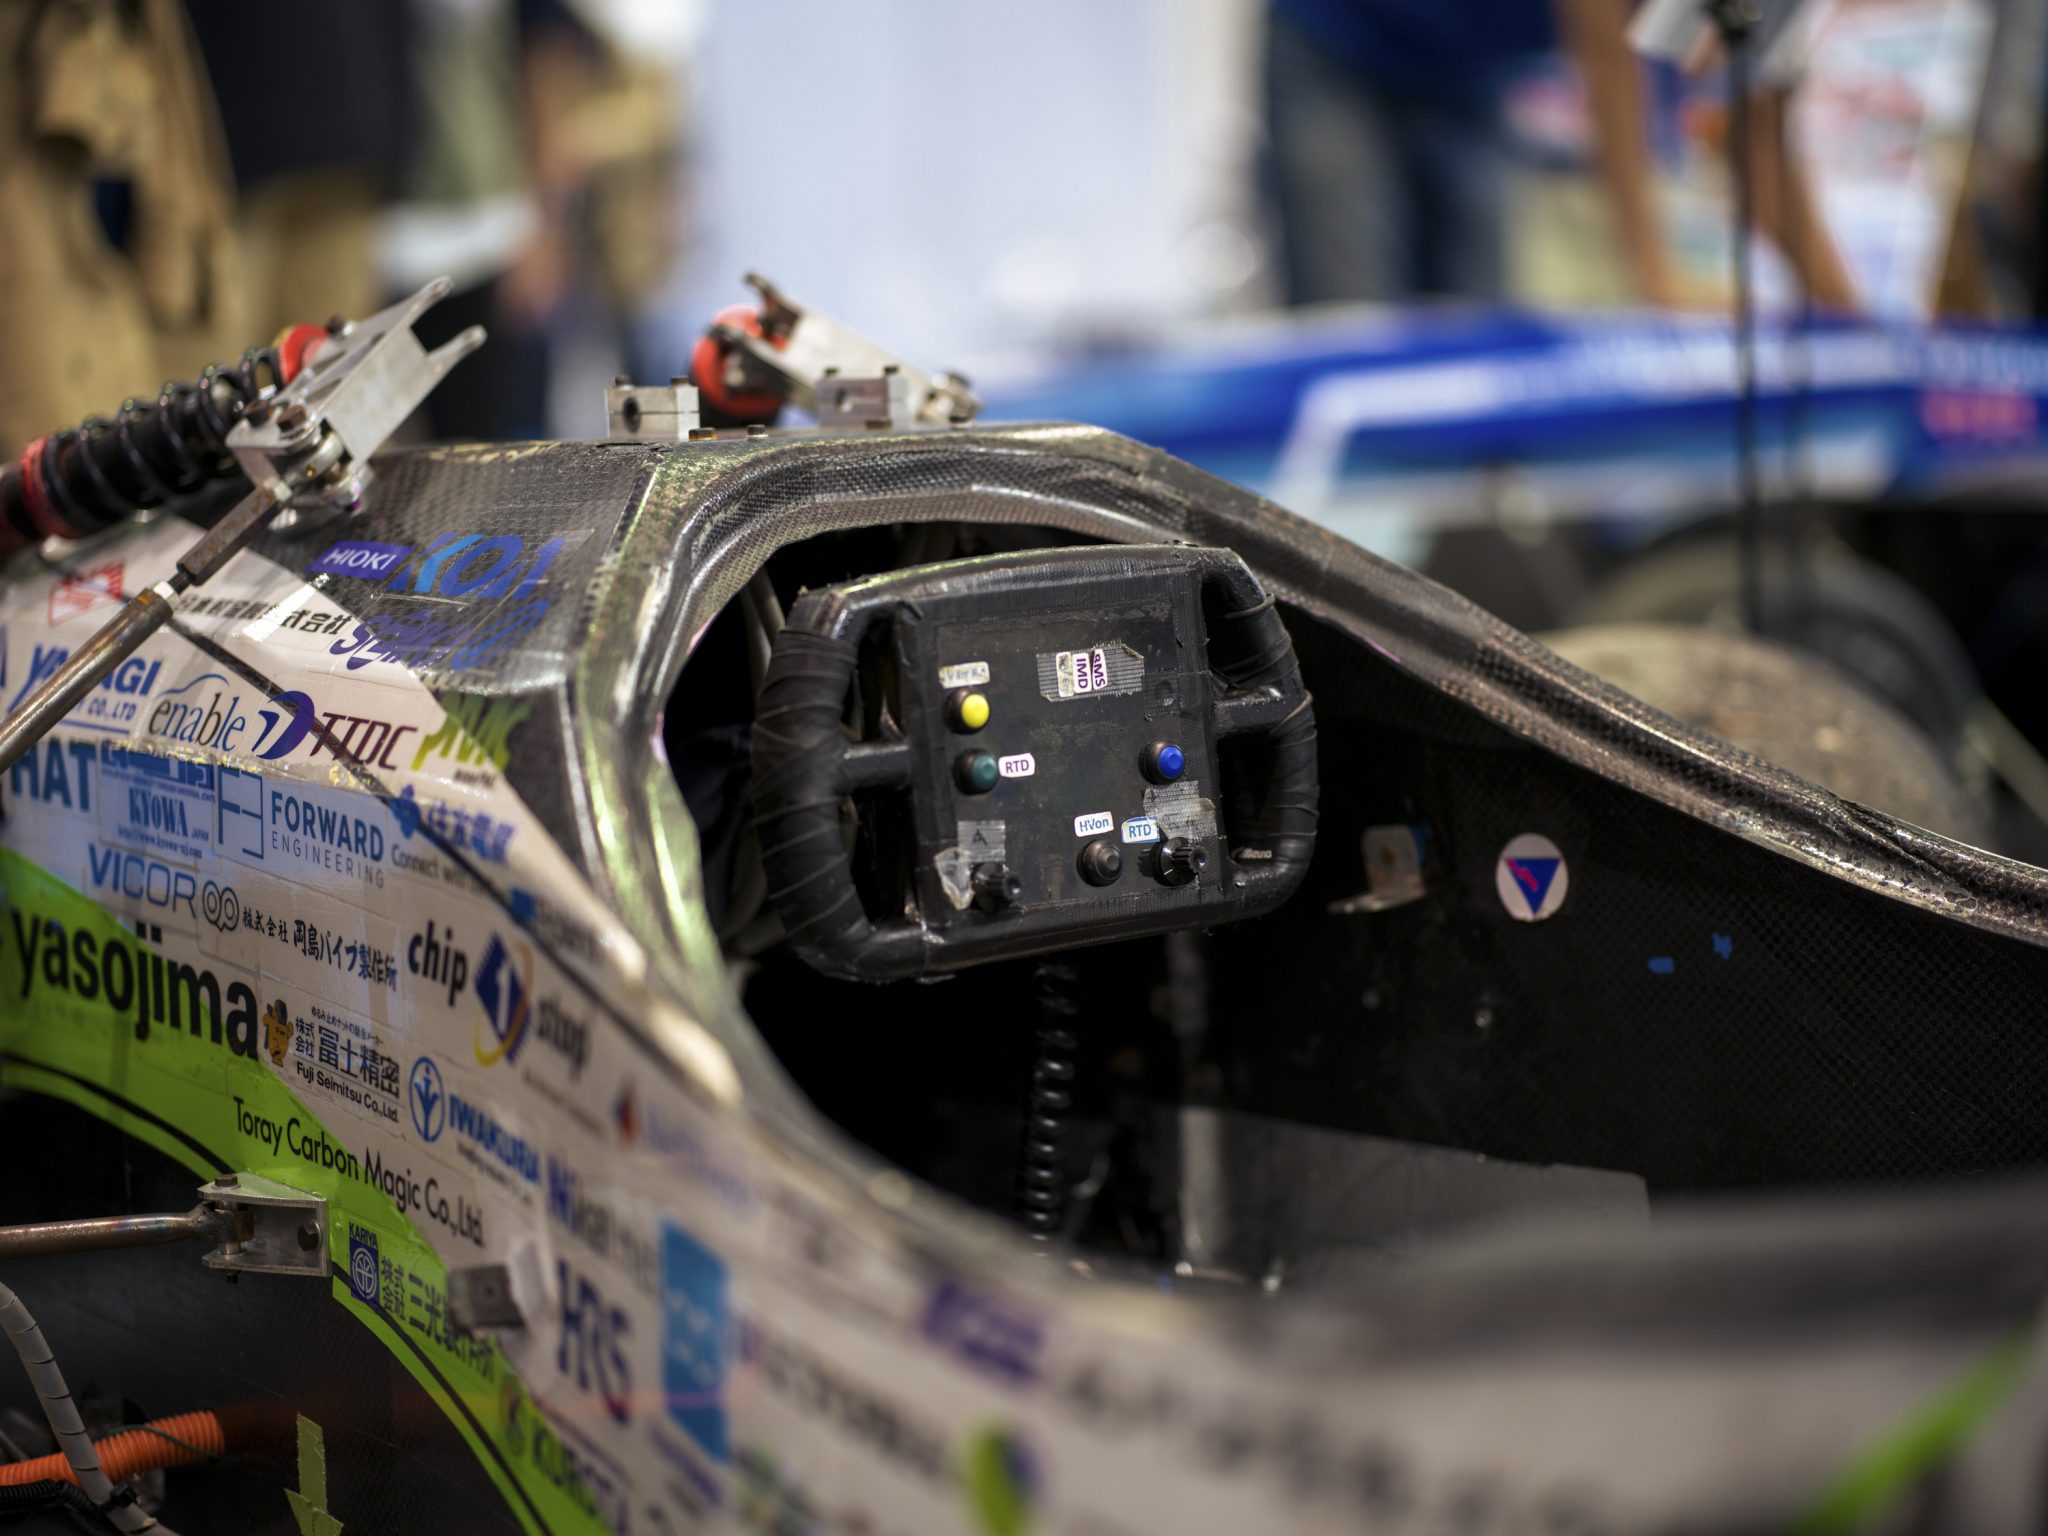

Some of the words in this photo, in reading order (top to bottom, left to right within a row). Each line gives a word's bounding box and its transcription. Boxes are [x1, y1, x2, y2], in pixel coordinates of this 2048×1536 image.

[323, 548, 397, 571] HIOKI
[1076, 658, 1089, 689] IMD
[148, 692, 246, 751] enable
[310, 712, 418, 771] TTDC
[1005, 759, 1030, 774] RTD
[129, 786, 188, 838] KYOWA
[271, 790, 384, 862] FORWARD
[1079, 818, 1109, 832] HVon
[1128, 823, 1152, 838] RTD
[88, 842, 197, 919] VICOR
[271, 831, 385, 889] ENGINEERING
[242, 907, 289, 944] 株式会社
[293, 919, 398, 991] 岡島パイプ製作所
[408, 920, 468, 1007] chip
[11, 907, 260, 1062] yasojima
[296, 1061, 315, 1084] Fuji
[316, 1070, 362, 1105] Seimitsu
[318, 1025, 400, 1099] 富士精密
[233, 1097, 283, 1157] Toray
[287, 1117, 359, 1181] Carbon
[364, 1146, 421, 1214] Magic
[349, 1221, 379, 1250] KARIYA
